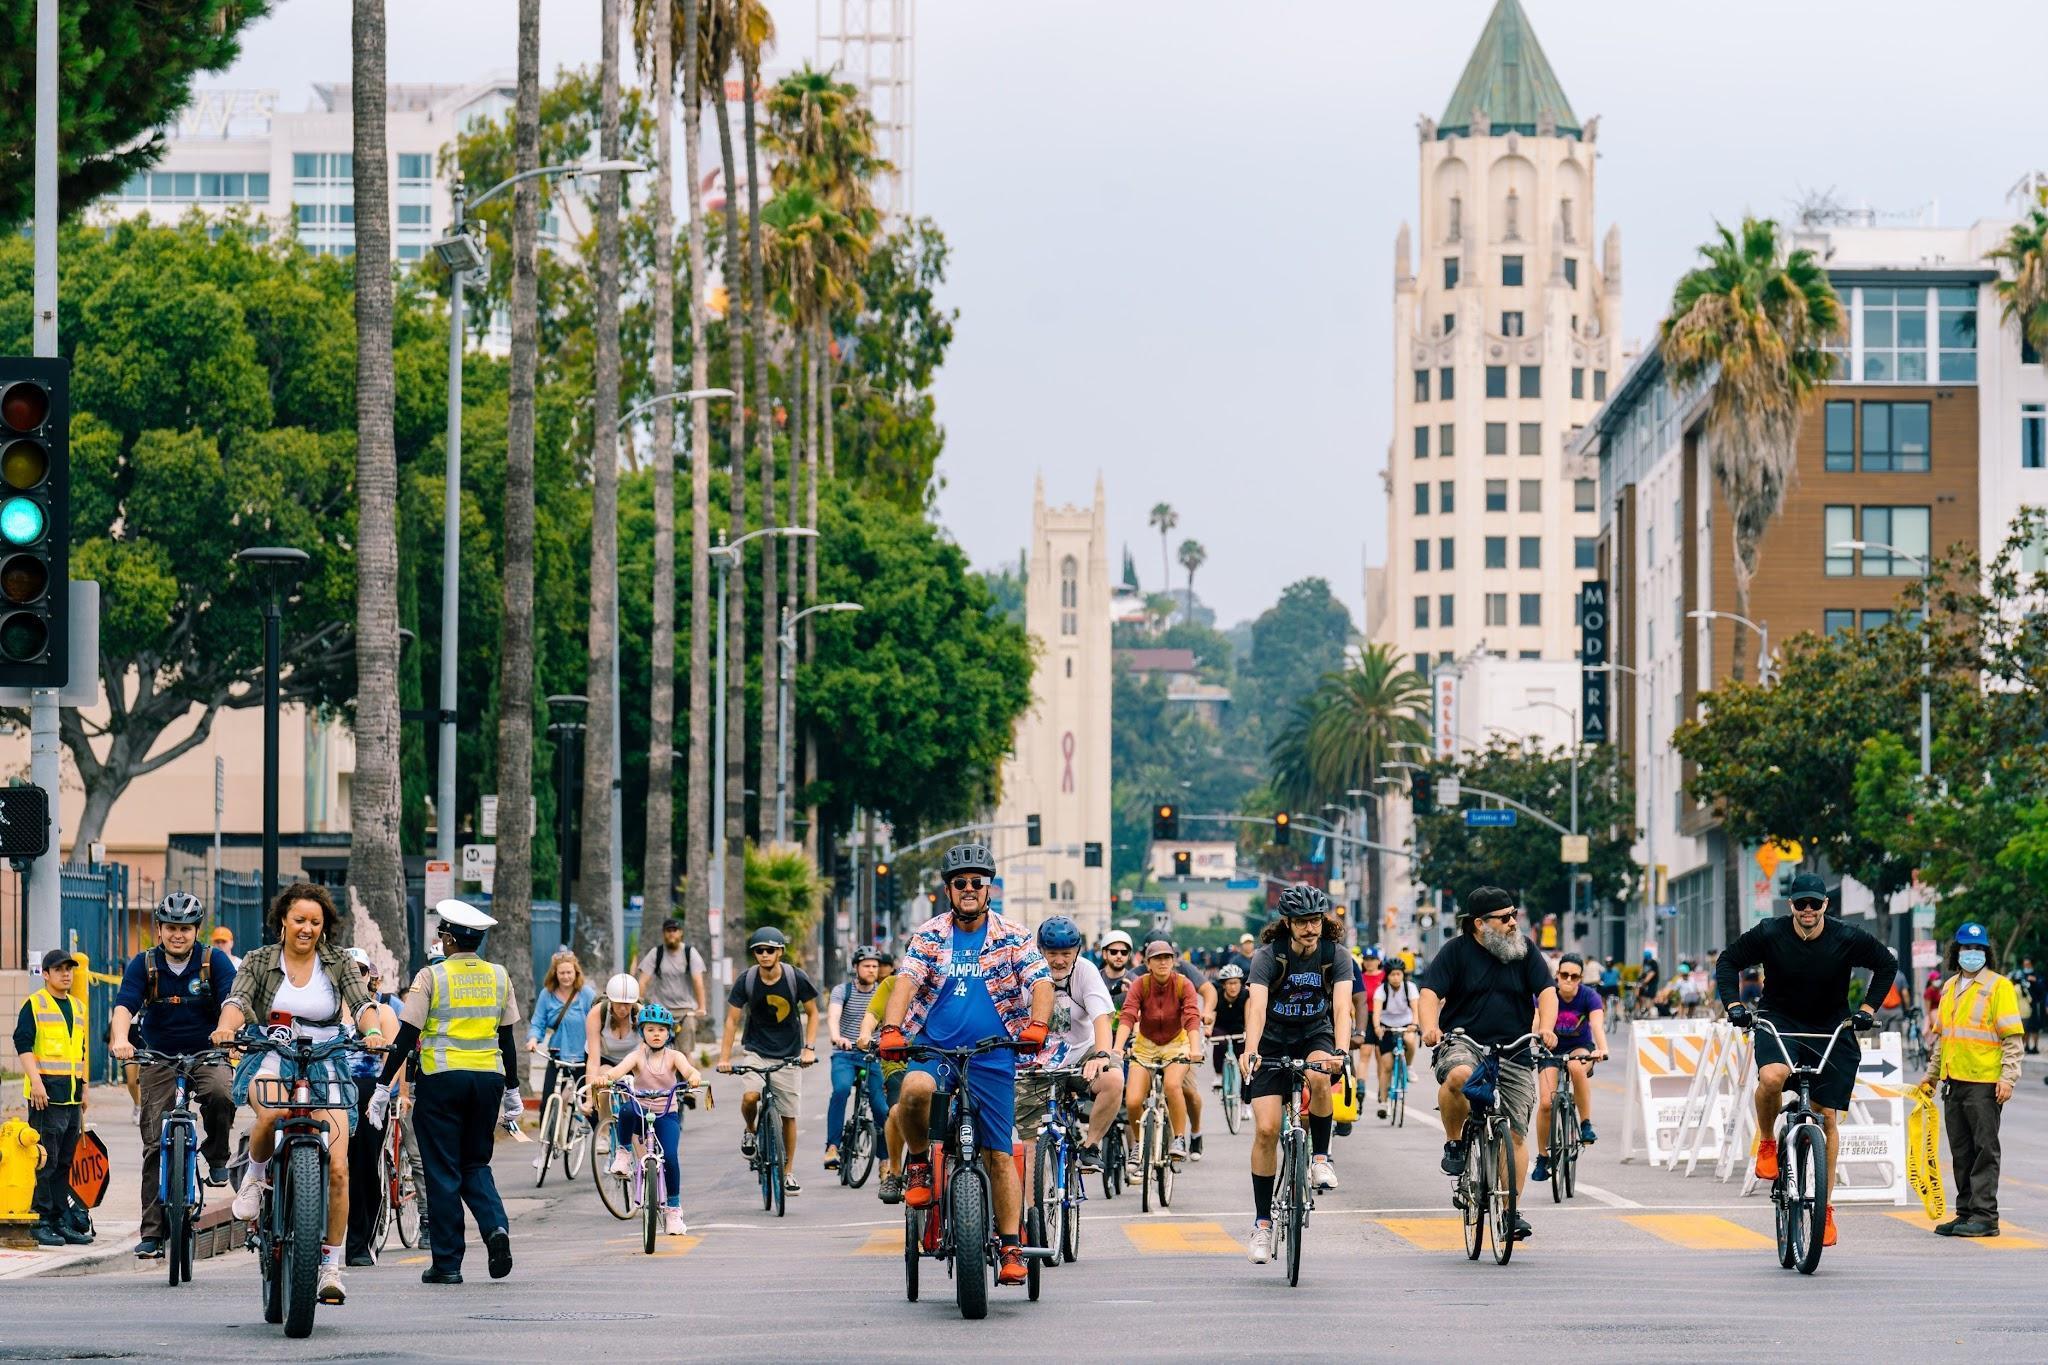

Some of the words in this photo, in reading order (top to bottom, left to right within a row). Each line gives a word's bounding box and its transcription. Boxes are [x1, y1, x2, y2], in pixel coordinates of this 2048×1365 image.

[1584, 587, 1605, 731] MODERA
[452, 973, 493, 986] TRAFFIC
[453, 985, 494, 1000] OFFICER
[1868, 1139, 1888, 1147] WORKS
[1851, 1146, 1888, 1155] SERVICES
